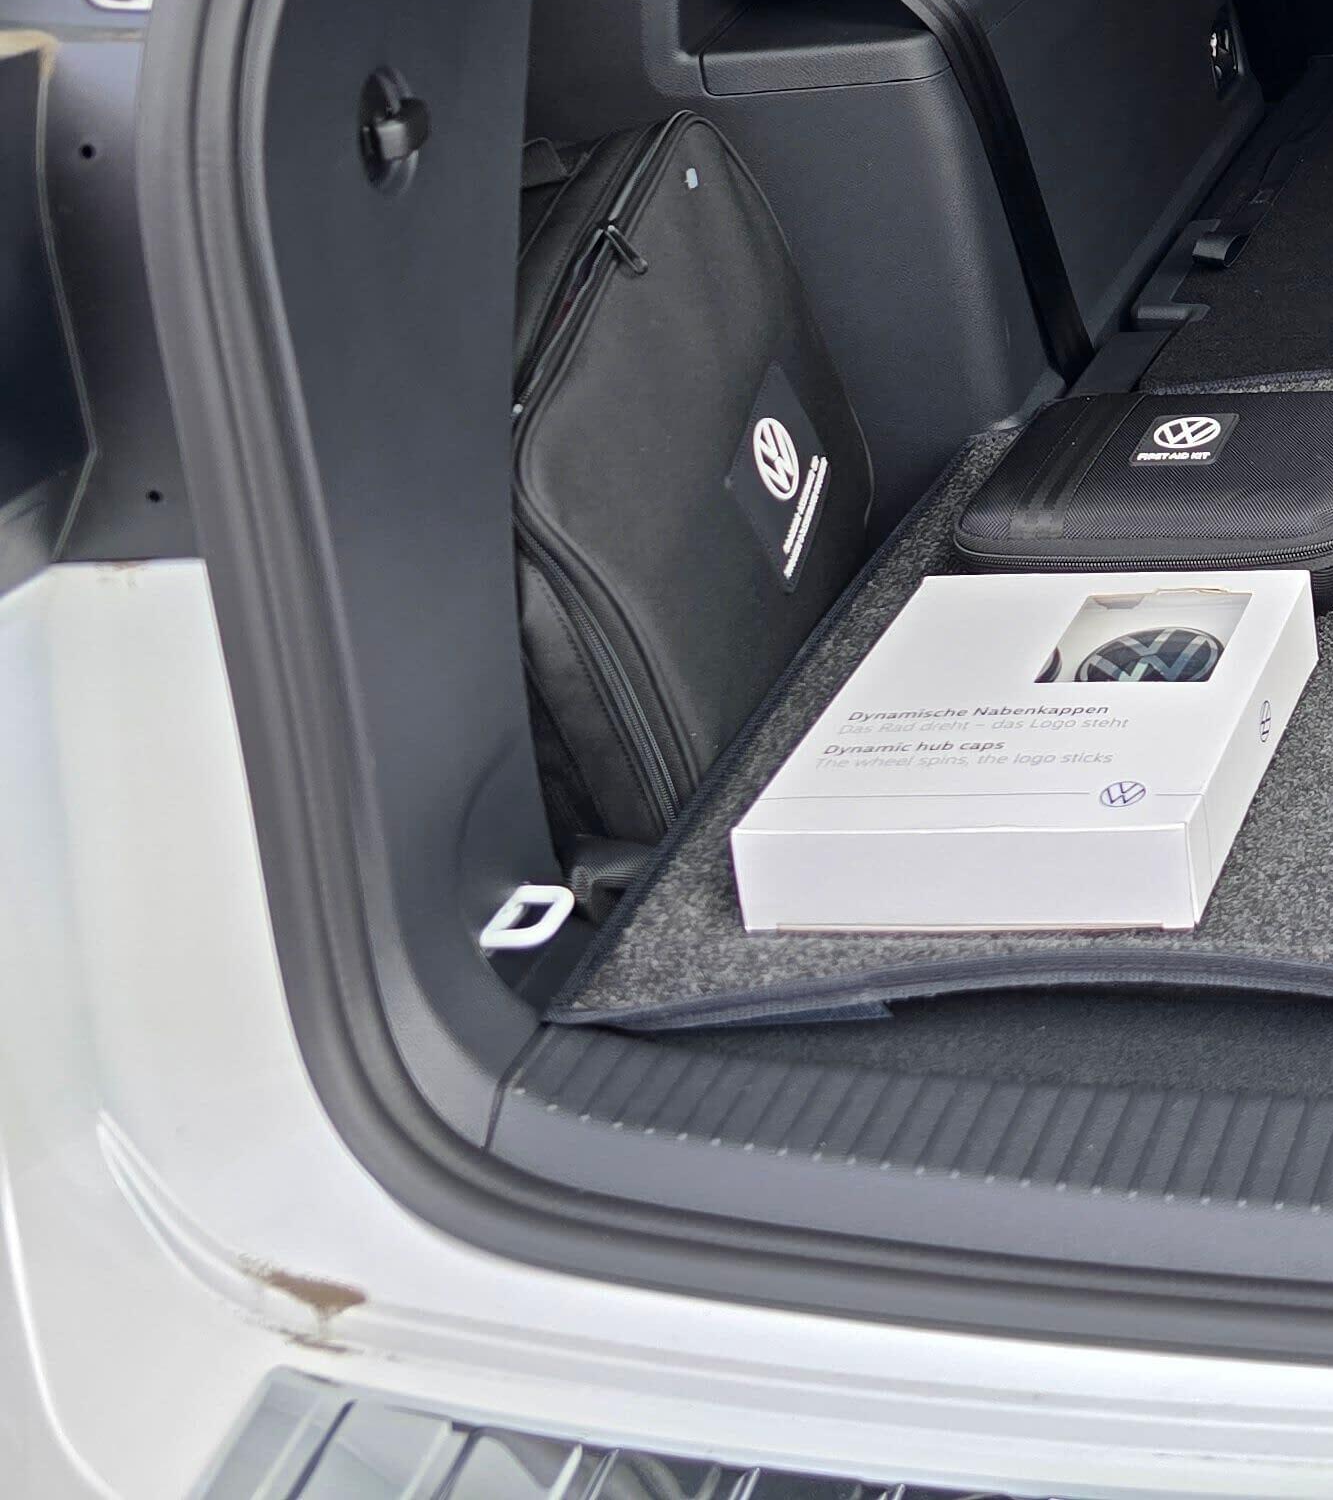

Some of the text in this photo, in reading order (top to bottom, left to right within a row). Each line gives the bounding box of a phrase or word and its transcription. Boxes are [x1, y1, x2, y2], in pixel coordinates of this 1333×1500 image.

[1168, 451, 1190, 460] AID
[1190, 451, 1211, 460] KIT
[848, 704, 1109, 722] Dynamische Nabenkappen
[838, 723, 873, 735] Das
[878, 722, 917, 733] Rad
[919, 720, 971, 732] dreht
[991, 719, 1024, 730] das
[1029, 718, 1077, 731] Logo
[1081, 717, 1129, 729] steht
[823, 740, 1006, 756] Dynamic hub caps
[815, 752, 1113, 769] The wheel spins, the logo sticks
